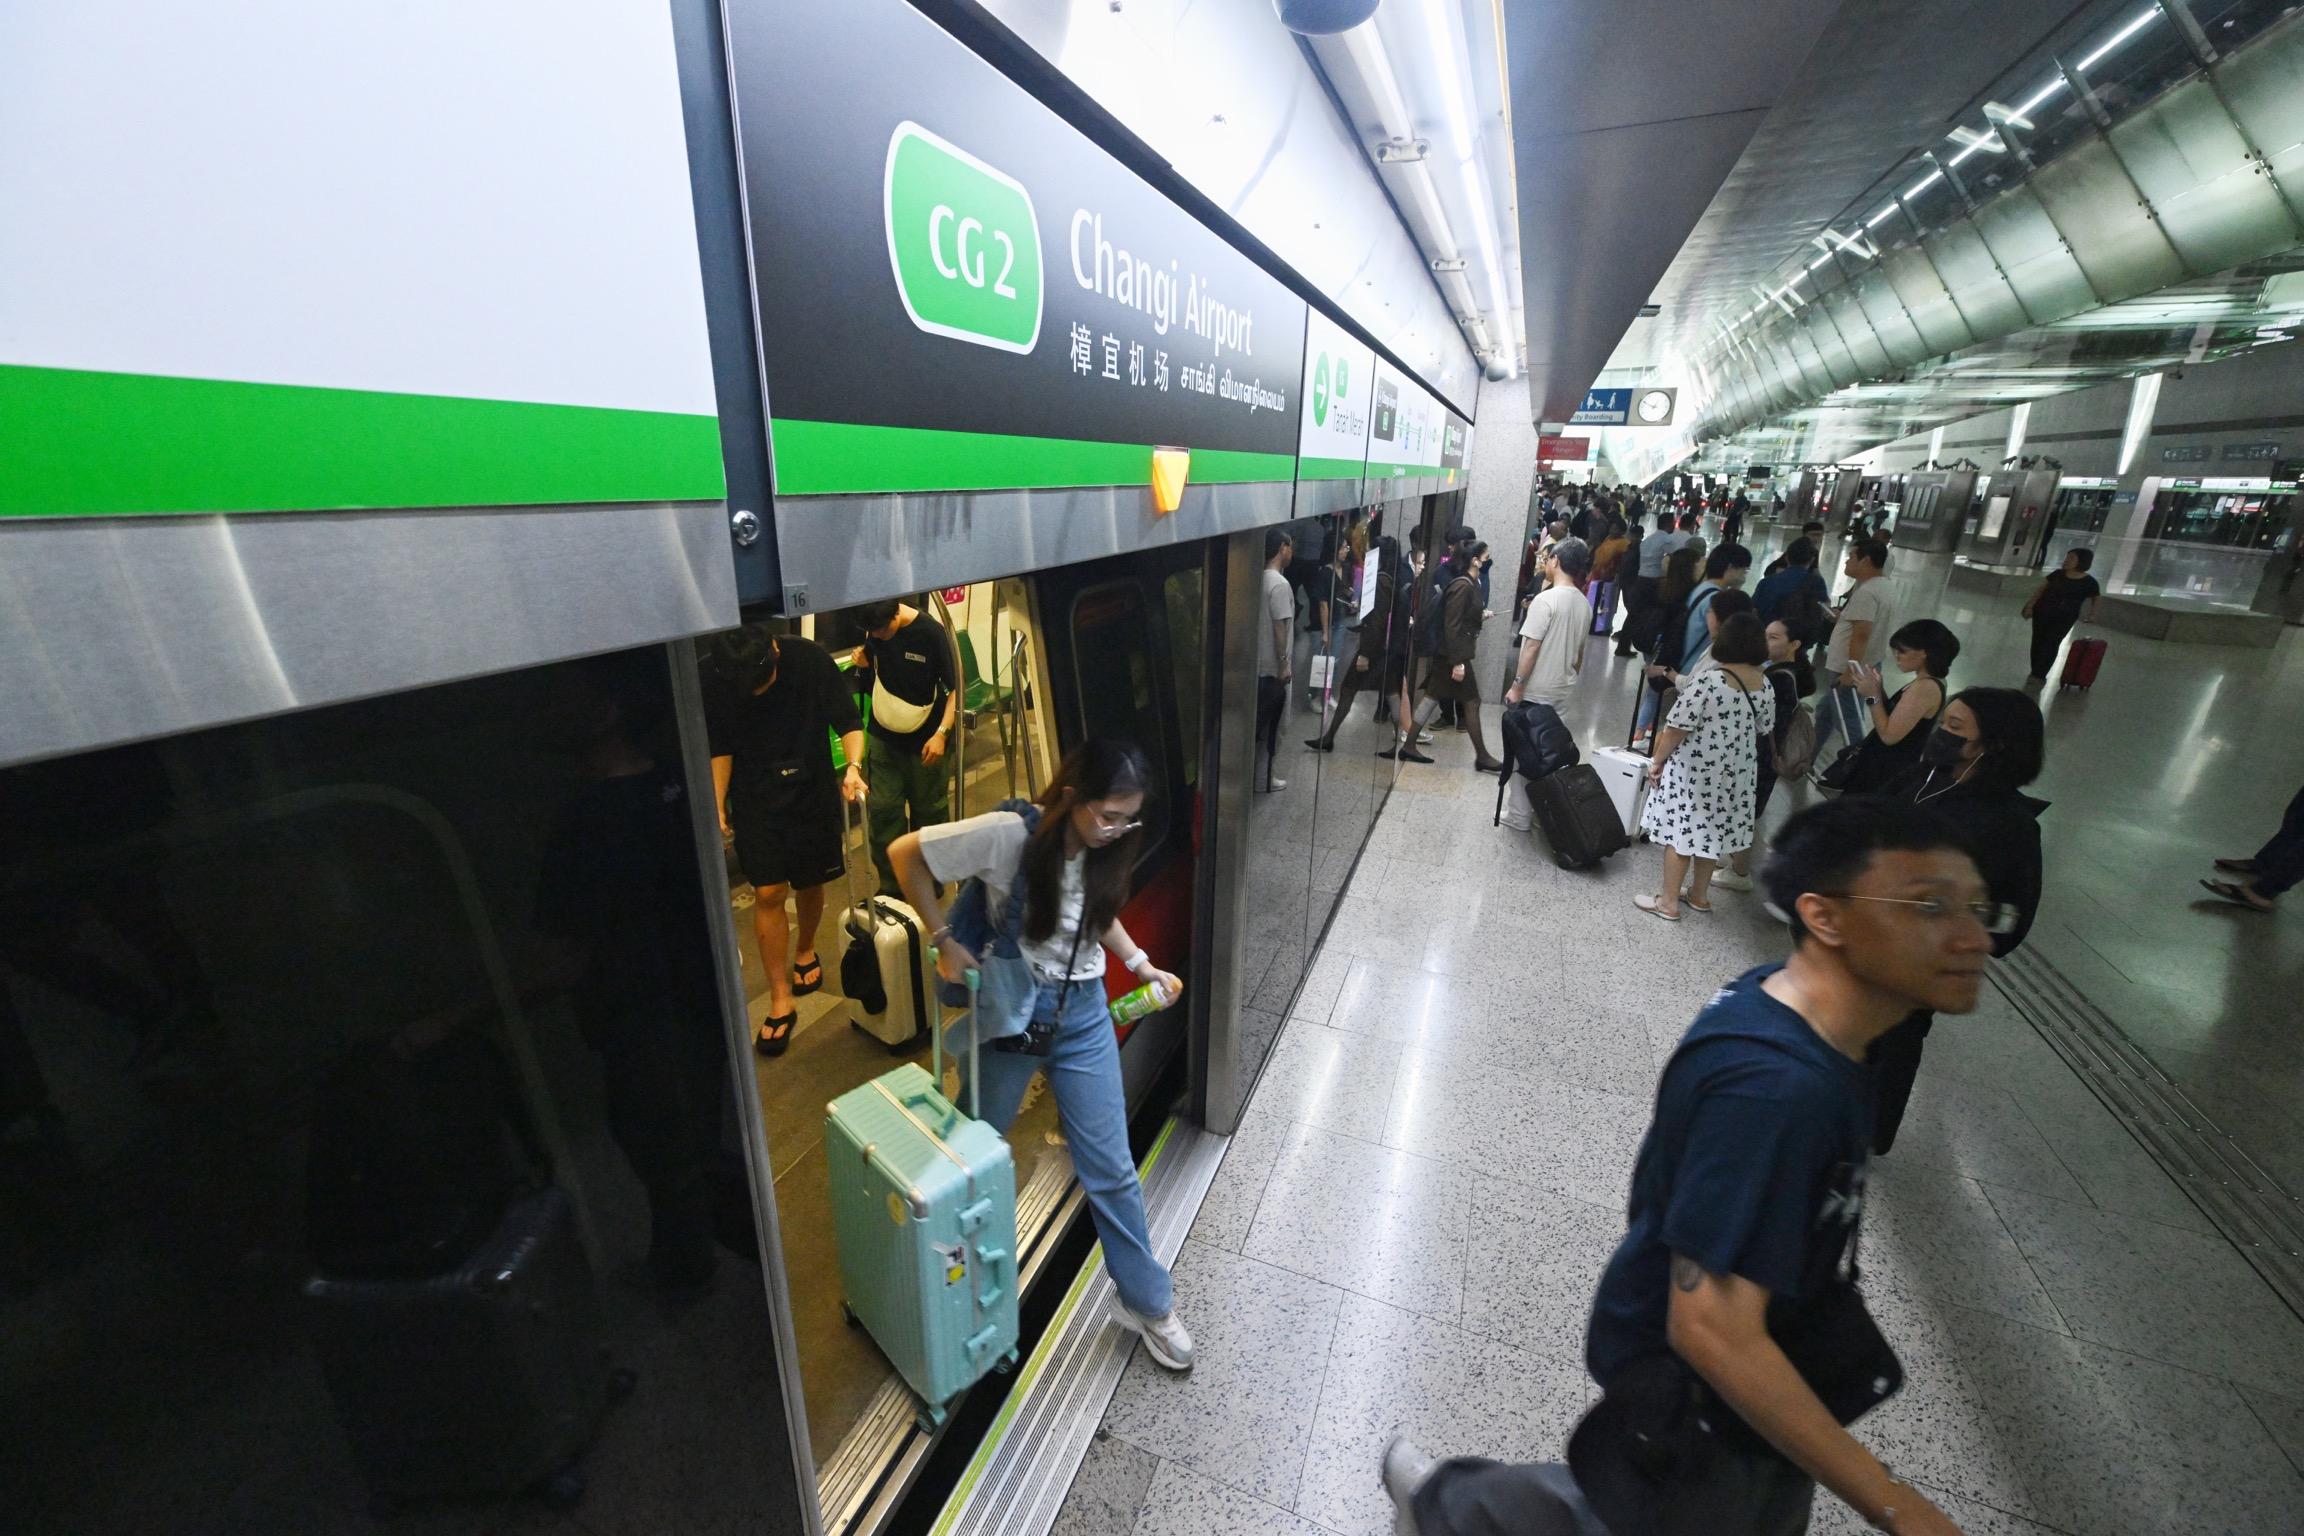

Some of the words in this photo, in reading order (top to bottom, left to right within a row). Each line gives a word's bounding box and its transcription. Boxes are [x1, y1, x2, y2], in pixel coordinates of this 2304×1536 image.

[1070, 208, 1178, 336] Changi
[1184, 272, 1253, 357] Airport
[1070, 321, 1169, 392] 樟宜机场
[1180, 362, 1216, 396] சாங்கி
[1584, 413, 1614, 421] Boarding
[792, 592, 806, 608] 16
